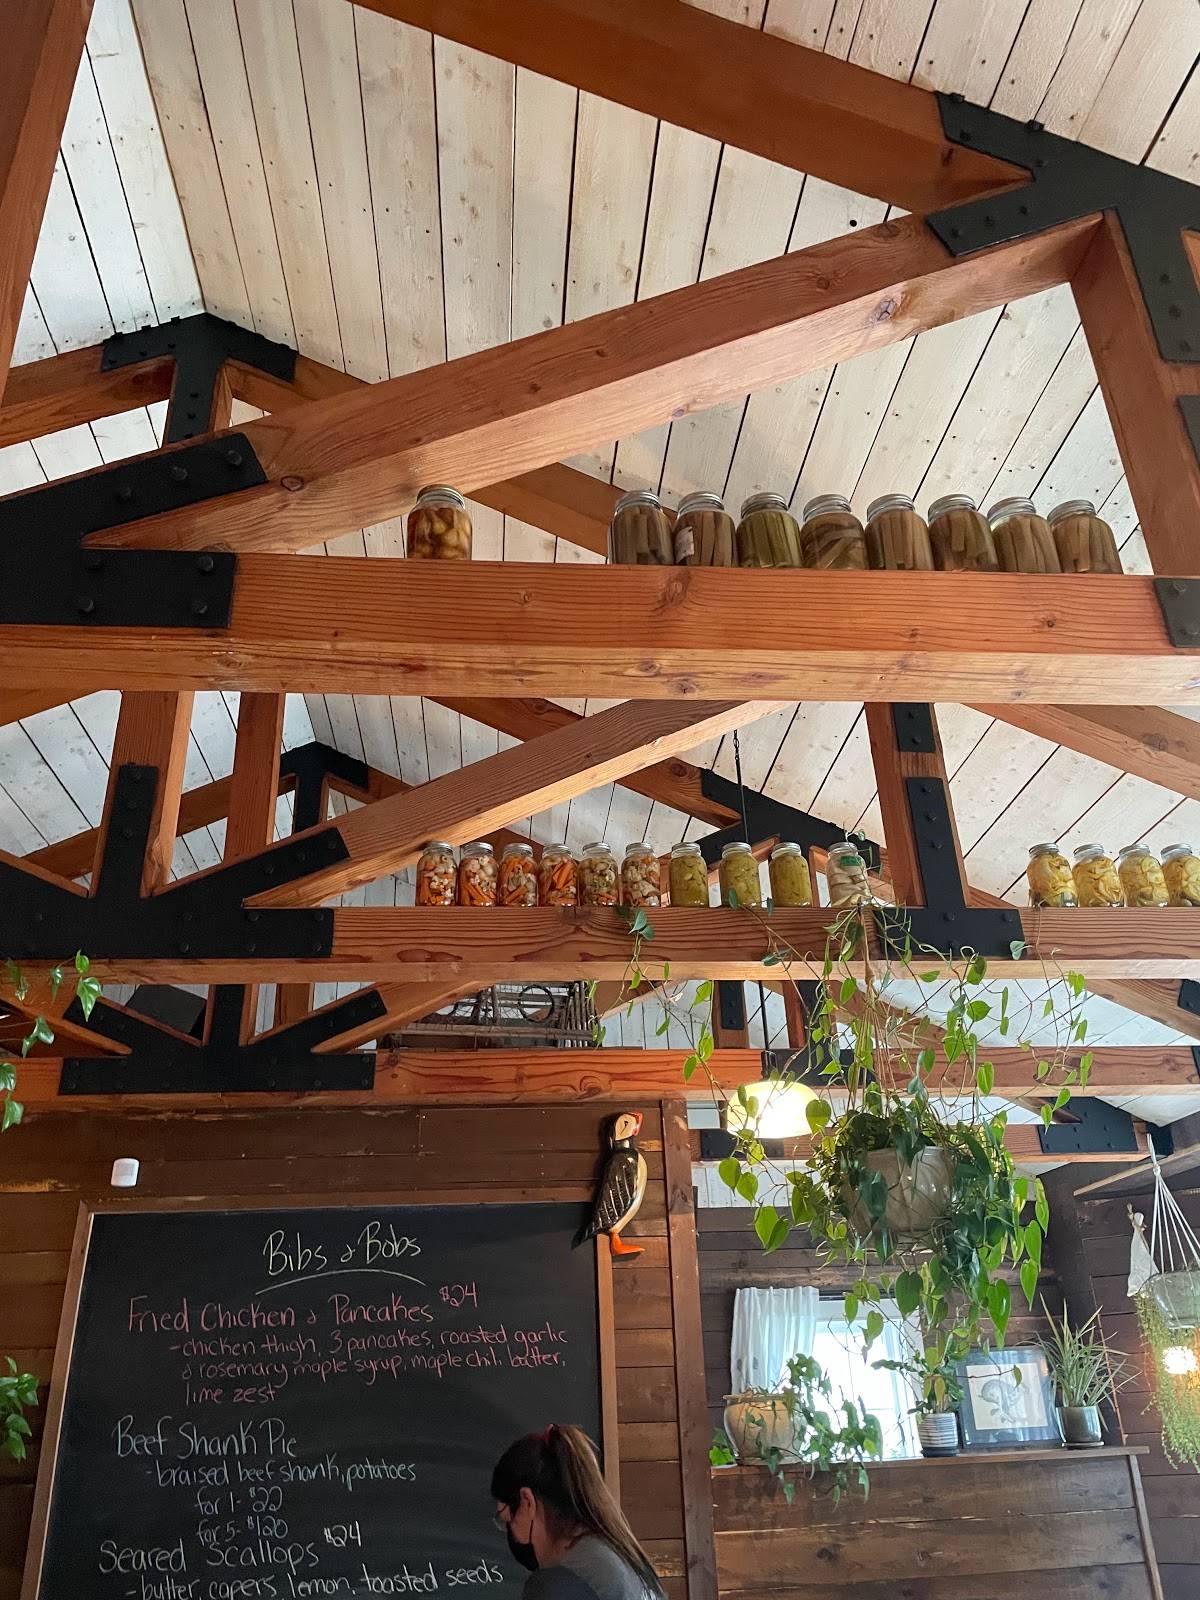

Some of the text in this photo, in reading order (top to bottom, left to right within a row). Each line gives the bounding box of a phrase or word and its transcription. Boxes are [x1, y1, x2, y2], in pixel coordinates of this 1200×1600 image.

[263, 1229, 328, 1276] Bibs
[357, 1220, 422, 1265] Bobs
[128, 1295, 190, 1333] Fried
[201, 1302, 295, 1332] Chicken
[328, 1292, 434, 1325] Pancakes
[438, 1281, 478, 1308] $24
[329, 1329, 343, 1354] 3
[440, 1324, 508, 1345] roasted
[514, 1321, 568, 1357] garlic
[199, 1361, 289, 1388] rosemary
[293, 1358, 348, 1383] maple
[410, 1350, 462, 1378] maple
[184, 1381, 277, 1406] lime zest
[111, 1414, 297, 1460] Beef Shank Pie
[238, 1460, 276, 1483] beef
[194, 1486, 222, 1515] for
[249, 1486, 283, 1513] $22
[99, 1520, 362, 1576] Seared Scallops $24
[196, 1518, 221, 1547] for
[247, 1515, 289, 1539] $120
[360, 1561, 439, 1595] toasted
[445, 1558, 504, 1587] seeds
